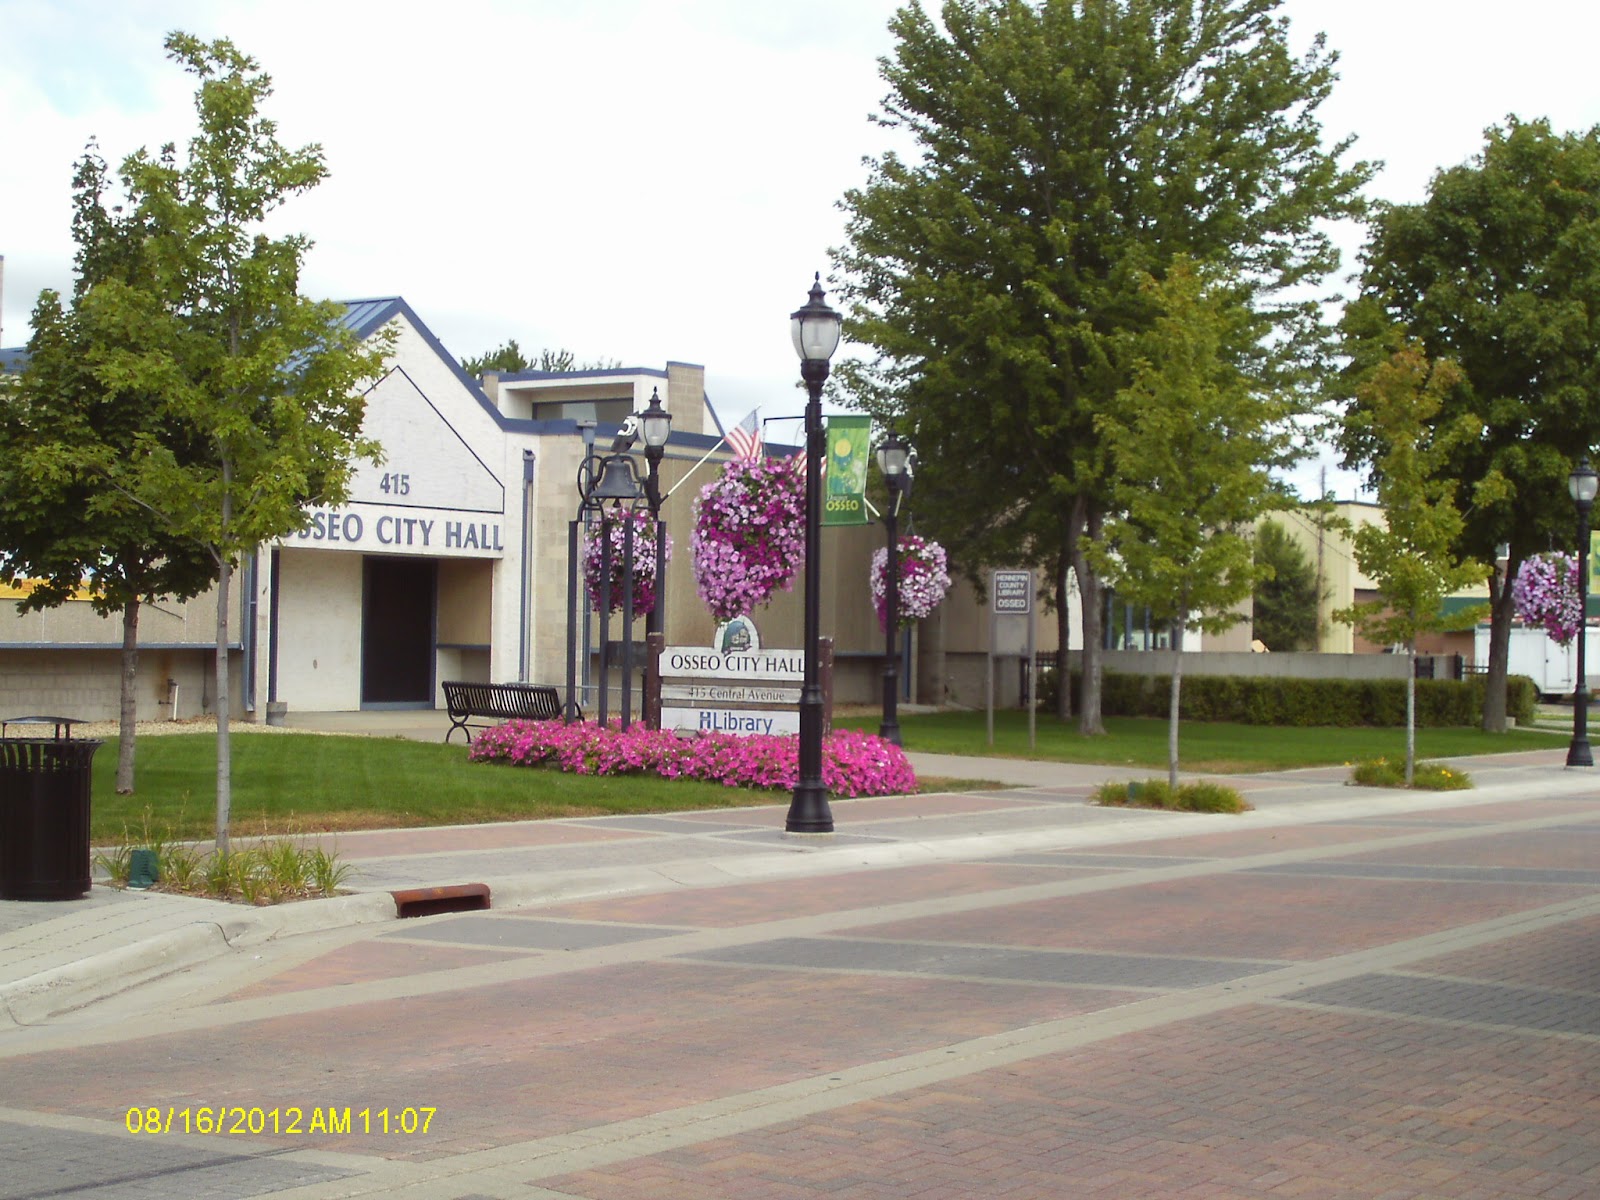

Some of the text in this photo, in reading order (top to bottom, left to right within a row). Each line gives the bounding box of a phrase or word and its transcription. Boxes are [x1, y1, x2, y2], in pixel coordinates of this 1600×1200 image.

[379, 473, 410, 495] 415
[826, 500, 859, 511] OSSEO
[376, 515, 434, 546] CITY
[445, 521, 504, 551] HALL
[998, 589, 1026, 597] LIBRARY
[998, 599, 1026, 608] OSSEO
[671, 654, 805, 674] OSSEO CITY HALL
[688, 686, 786, 701] 415 Central Avenue
